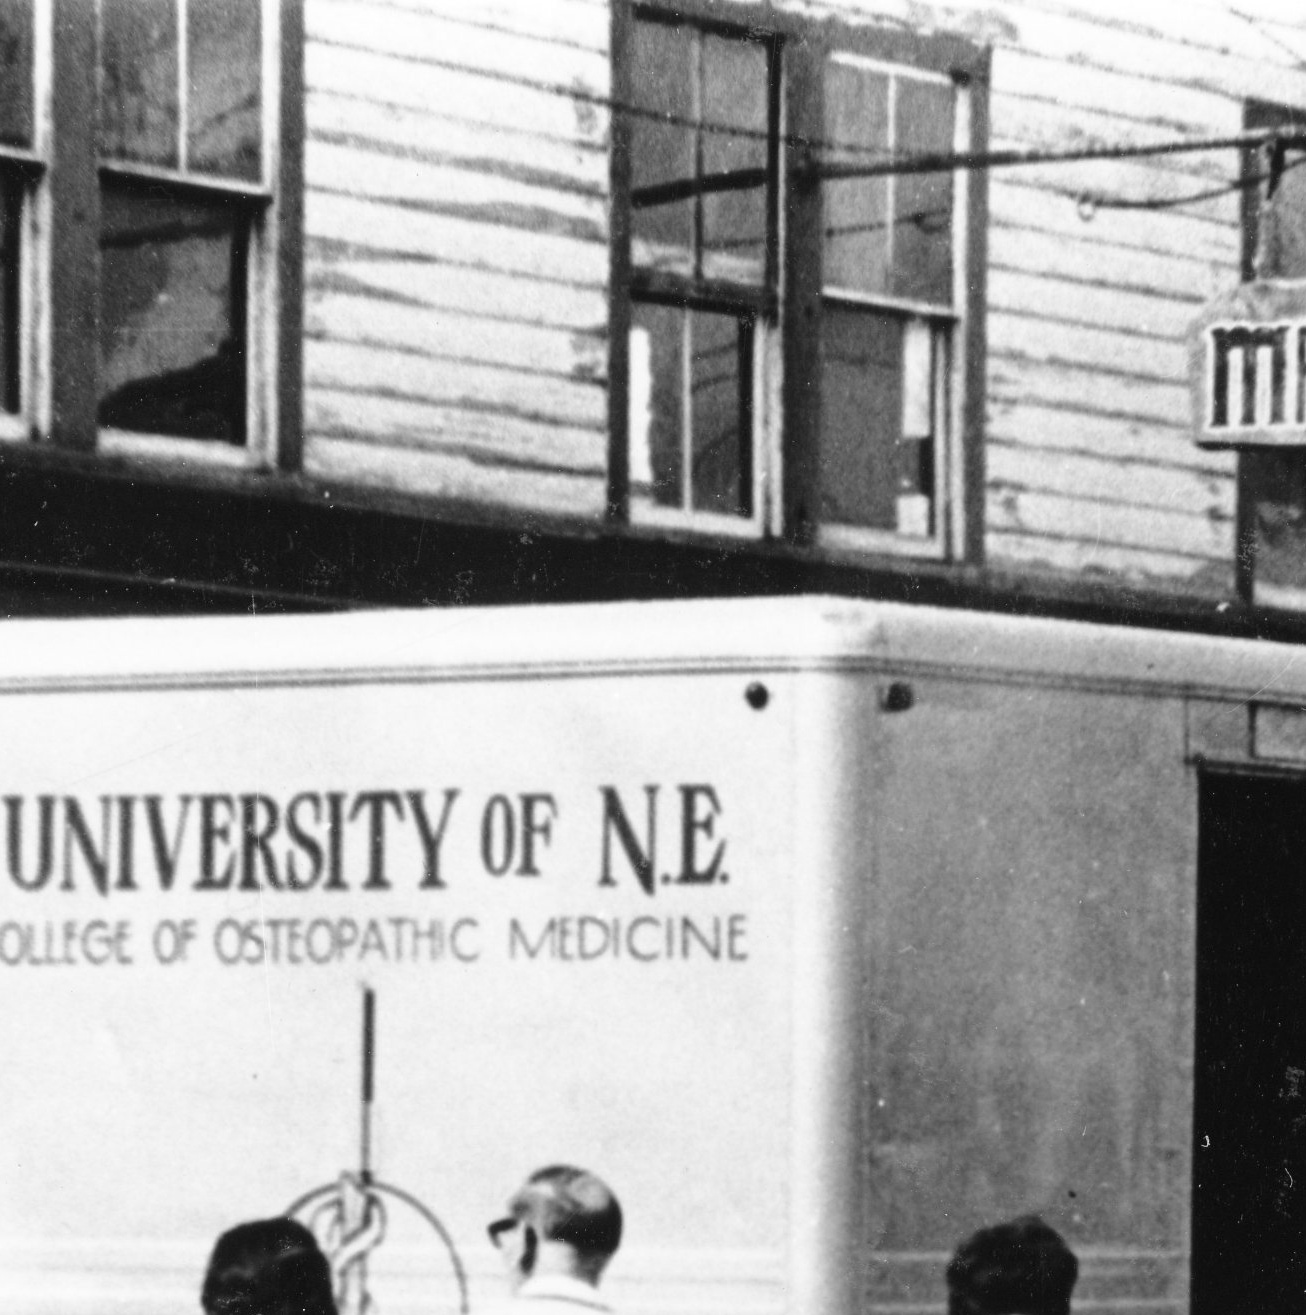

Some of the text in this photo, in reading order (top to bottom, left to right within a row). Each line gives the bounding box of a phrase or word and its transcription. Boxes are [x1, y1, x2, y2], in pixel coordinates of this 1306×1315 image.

[1, 783, 730, 896] UNIVERSITY OF N.E.
[152, 918, 199, 966] OF
[214, 916, 481, 966] OSTEOPATHIC
[509, 914, 749, 963] MEDICINE
